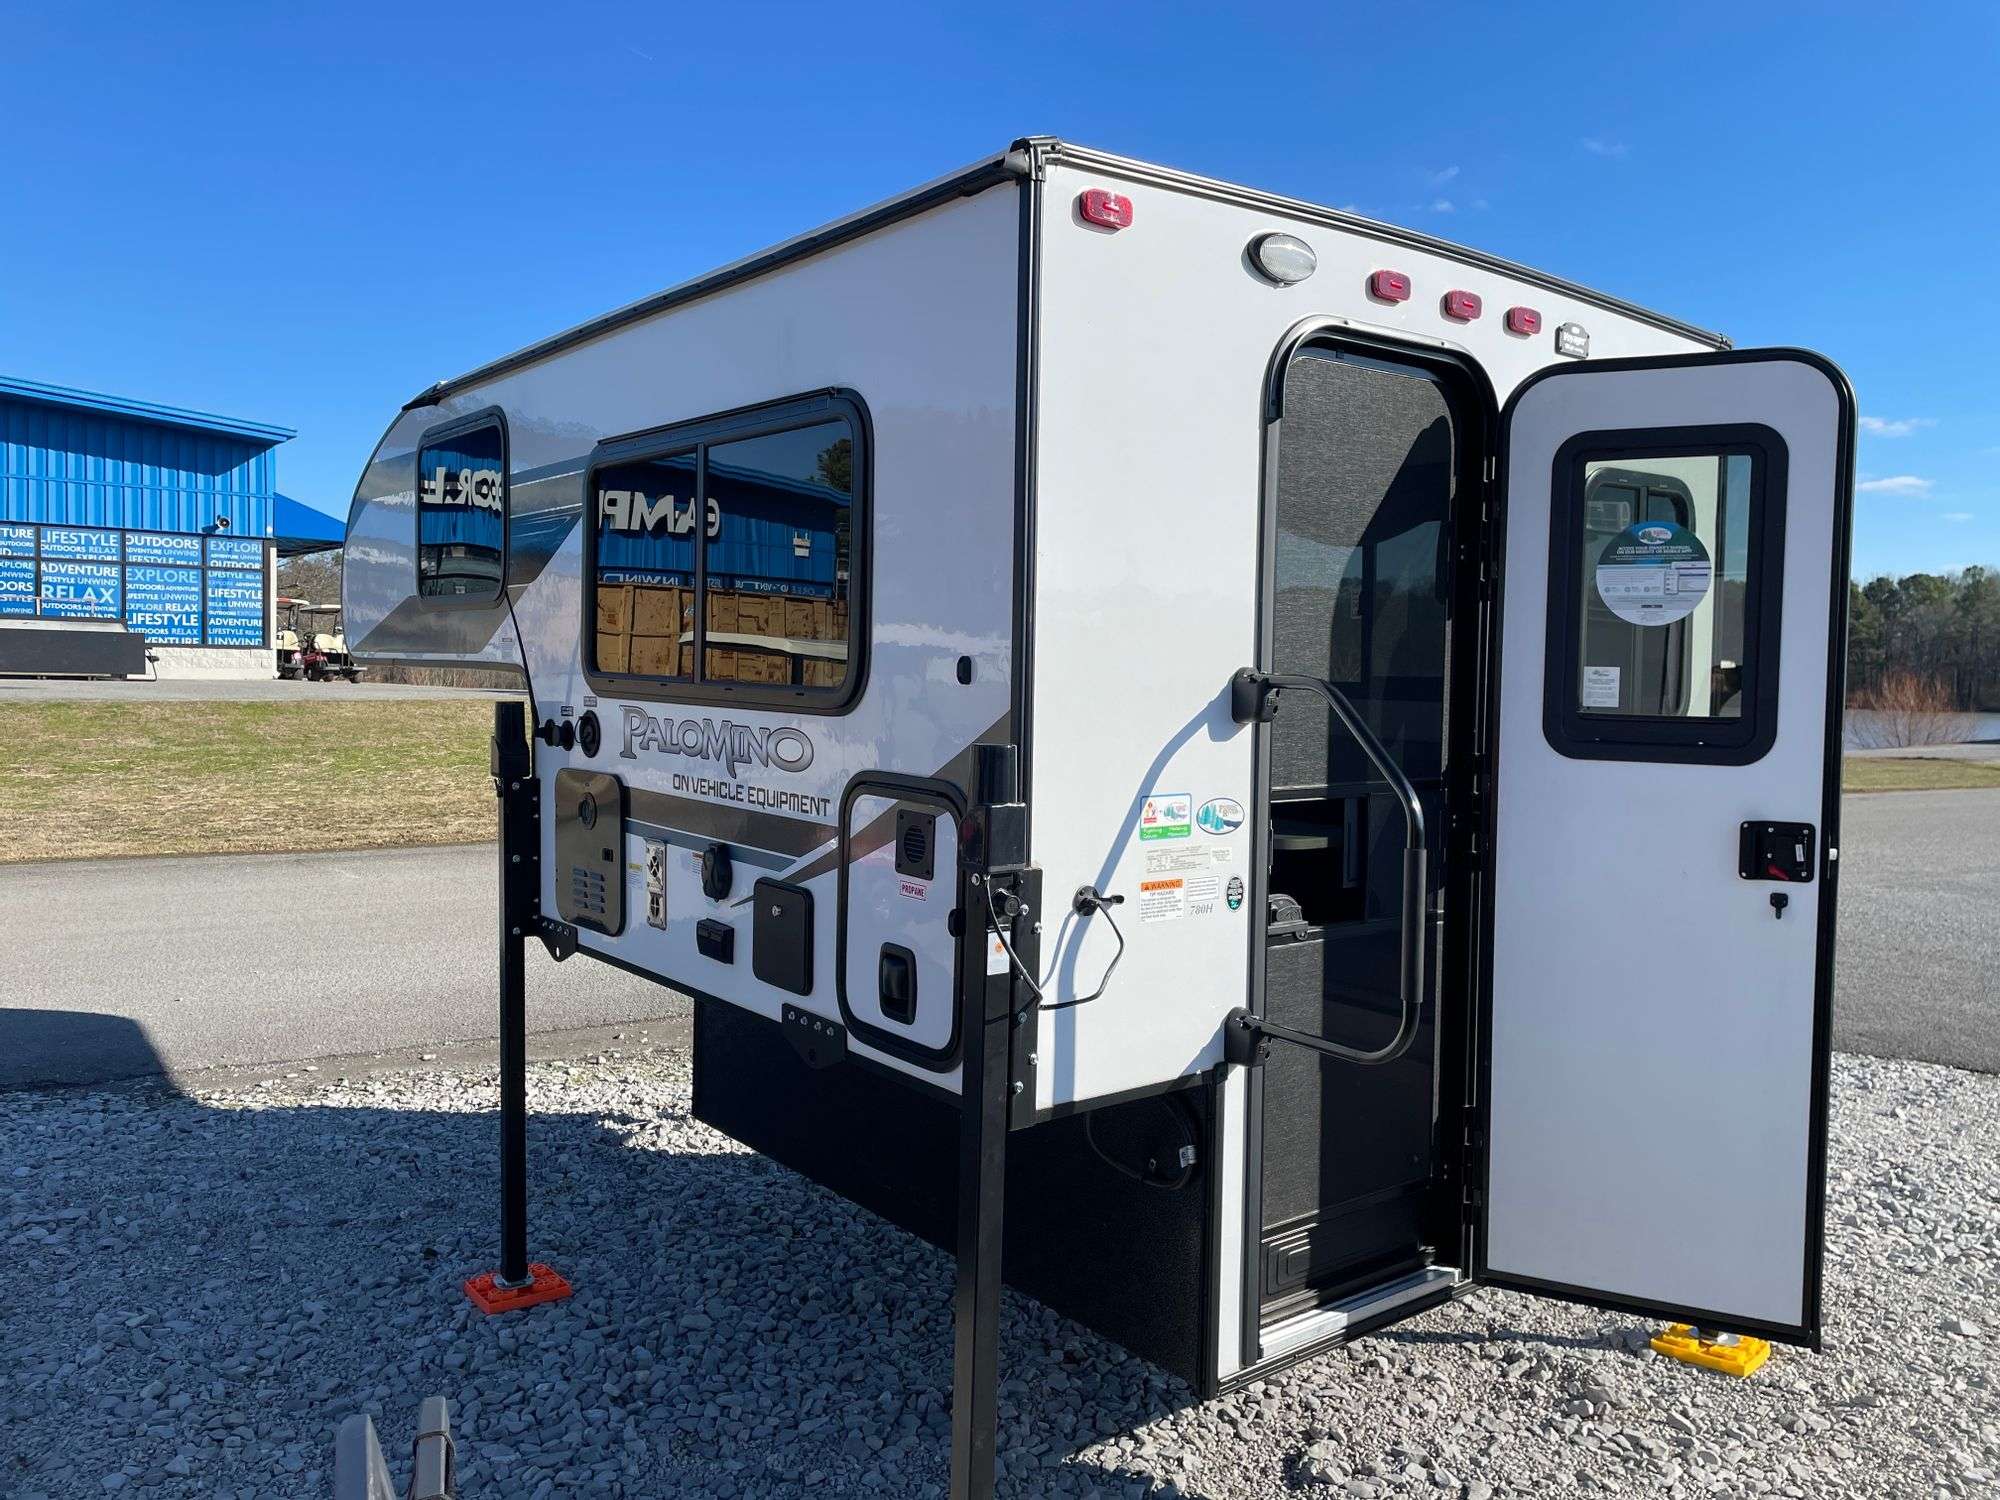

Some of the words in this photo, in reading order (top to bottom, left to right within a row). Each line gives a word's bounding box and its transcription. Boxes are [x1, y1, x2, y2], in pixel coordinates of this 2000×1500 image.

[126, 535, 199, 550] OUTDOORS
[128, 555, 174, 564] IFESTYLE
[210, 560, 262, 570] OUTDOOR
[41, 562, 119, 577] ADVENTURE
[126, 568, 198, 583] EXPLORE
[77, 578, 118, 587] UNWIND
[42, 584, 115, 604] RELAX
[160, 593, 199, 601] UNWIND
[208, 588, 263, 600] LIFESTYLE
[165, 603, 199, 612] RELAX
[228, 601, 263, 609] UNWIND
[126, 612, 199, 627] LIFESTYLE
[145, 637, 200, 645] VENTURE
[619, 704, 815, 779] PALOMINO
[672, 774, 690, 791] ON
[692, 777, 744, 802] VEHICLE
[749, 786, 831, 817] EQUIPMENT
[902, 883, 924, 897] PROPANE
